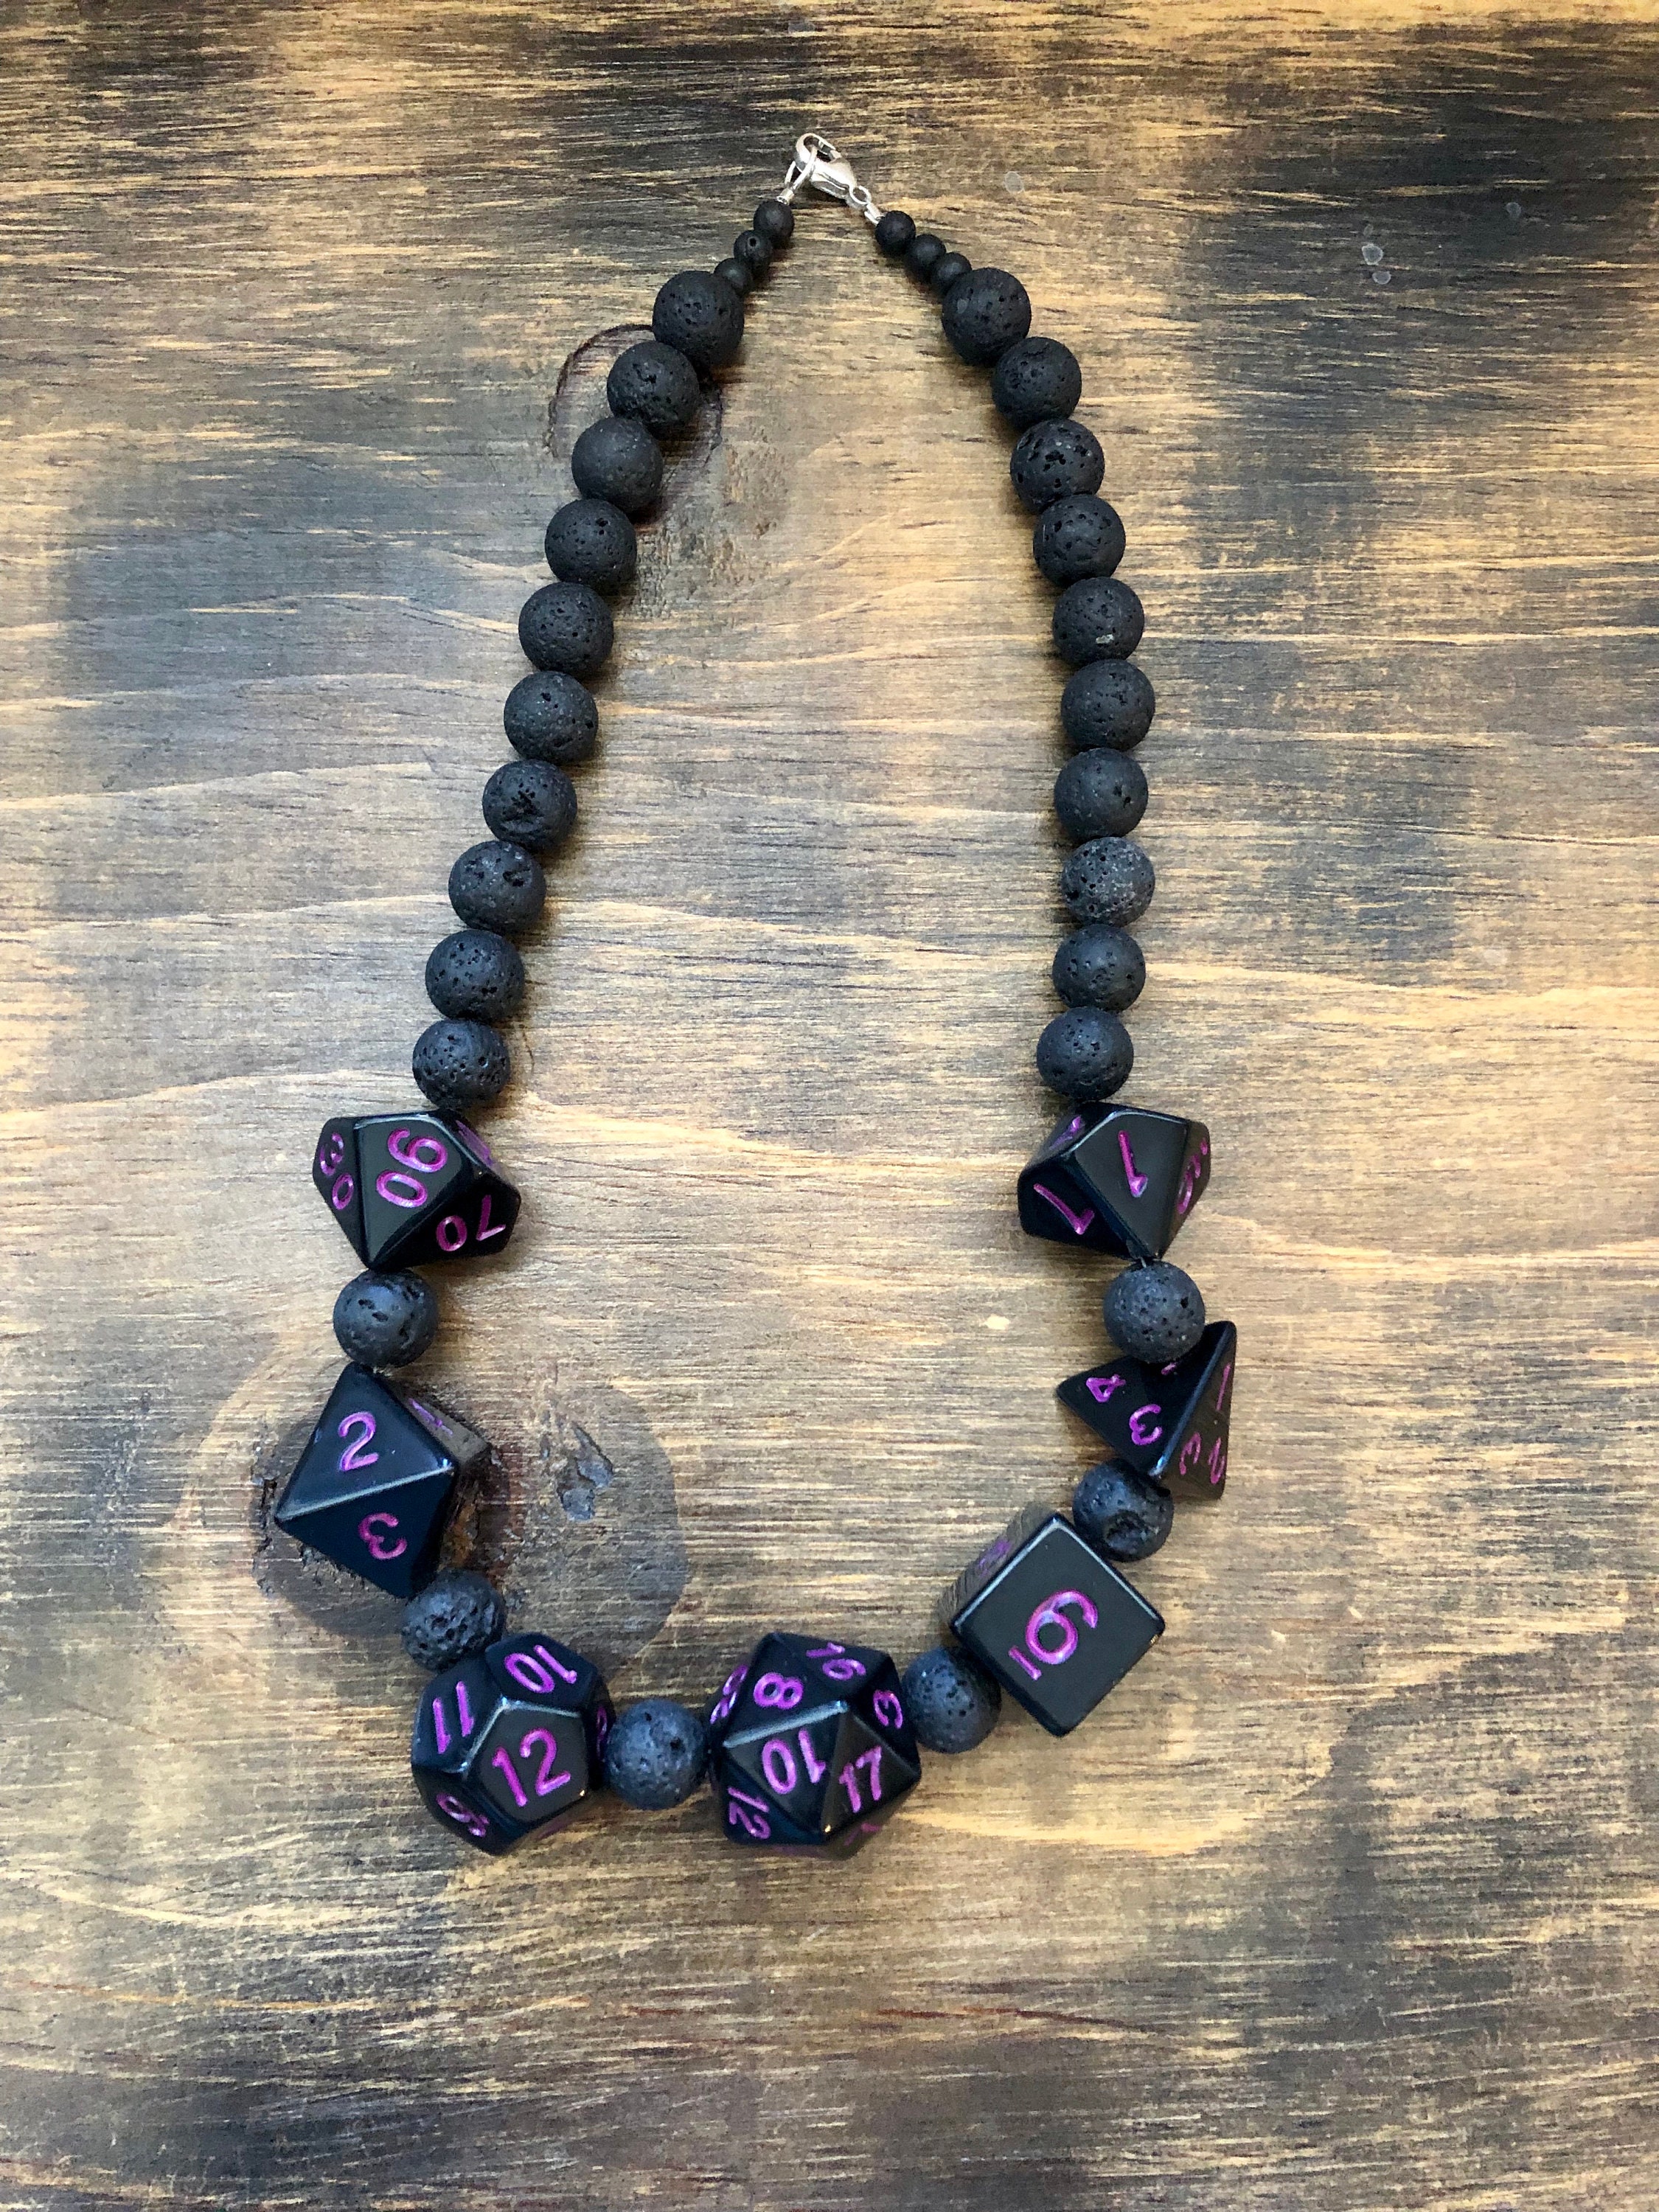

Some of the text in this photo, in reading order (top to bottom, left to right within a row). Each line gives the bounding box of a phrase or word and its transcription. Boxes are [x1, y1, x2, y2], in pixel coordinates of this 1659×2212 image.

[437, 1195, 506, 1252] 70
[1085, 1374, 1127, 1403] 4
[338, 1411, 379, 1471] 2
[1129, 1404, 1163, 1446] 3
[358, 1513, 406, 1559] 3
[504, 1645, 577, 1693] 10
[807, 1643, 866, 1680] 16
[754, 1673, 804, 1710] 8
[873, 1690, 903, 1728] 3
[433, 1681, 474, 1753] 11
[492, 1727, 571, 1806] 12
[762, 1730, 827, 1794] 10
[838, 1745, 882, 1812] 17
[728, 1787, 770, 1839] 12
